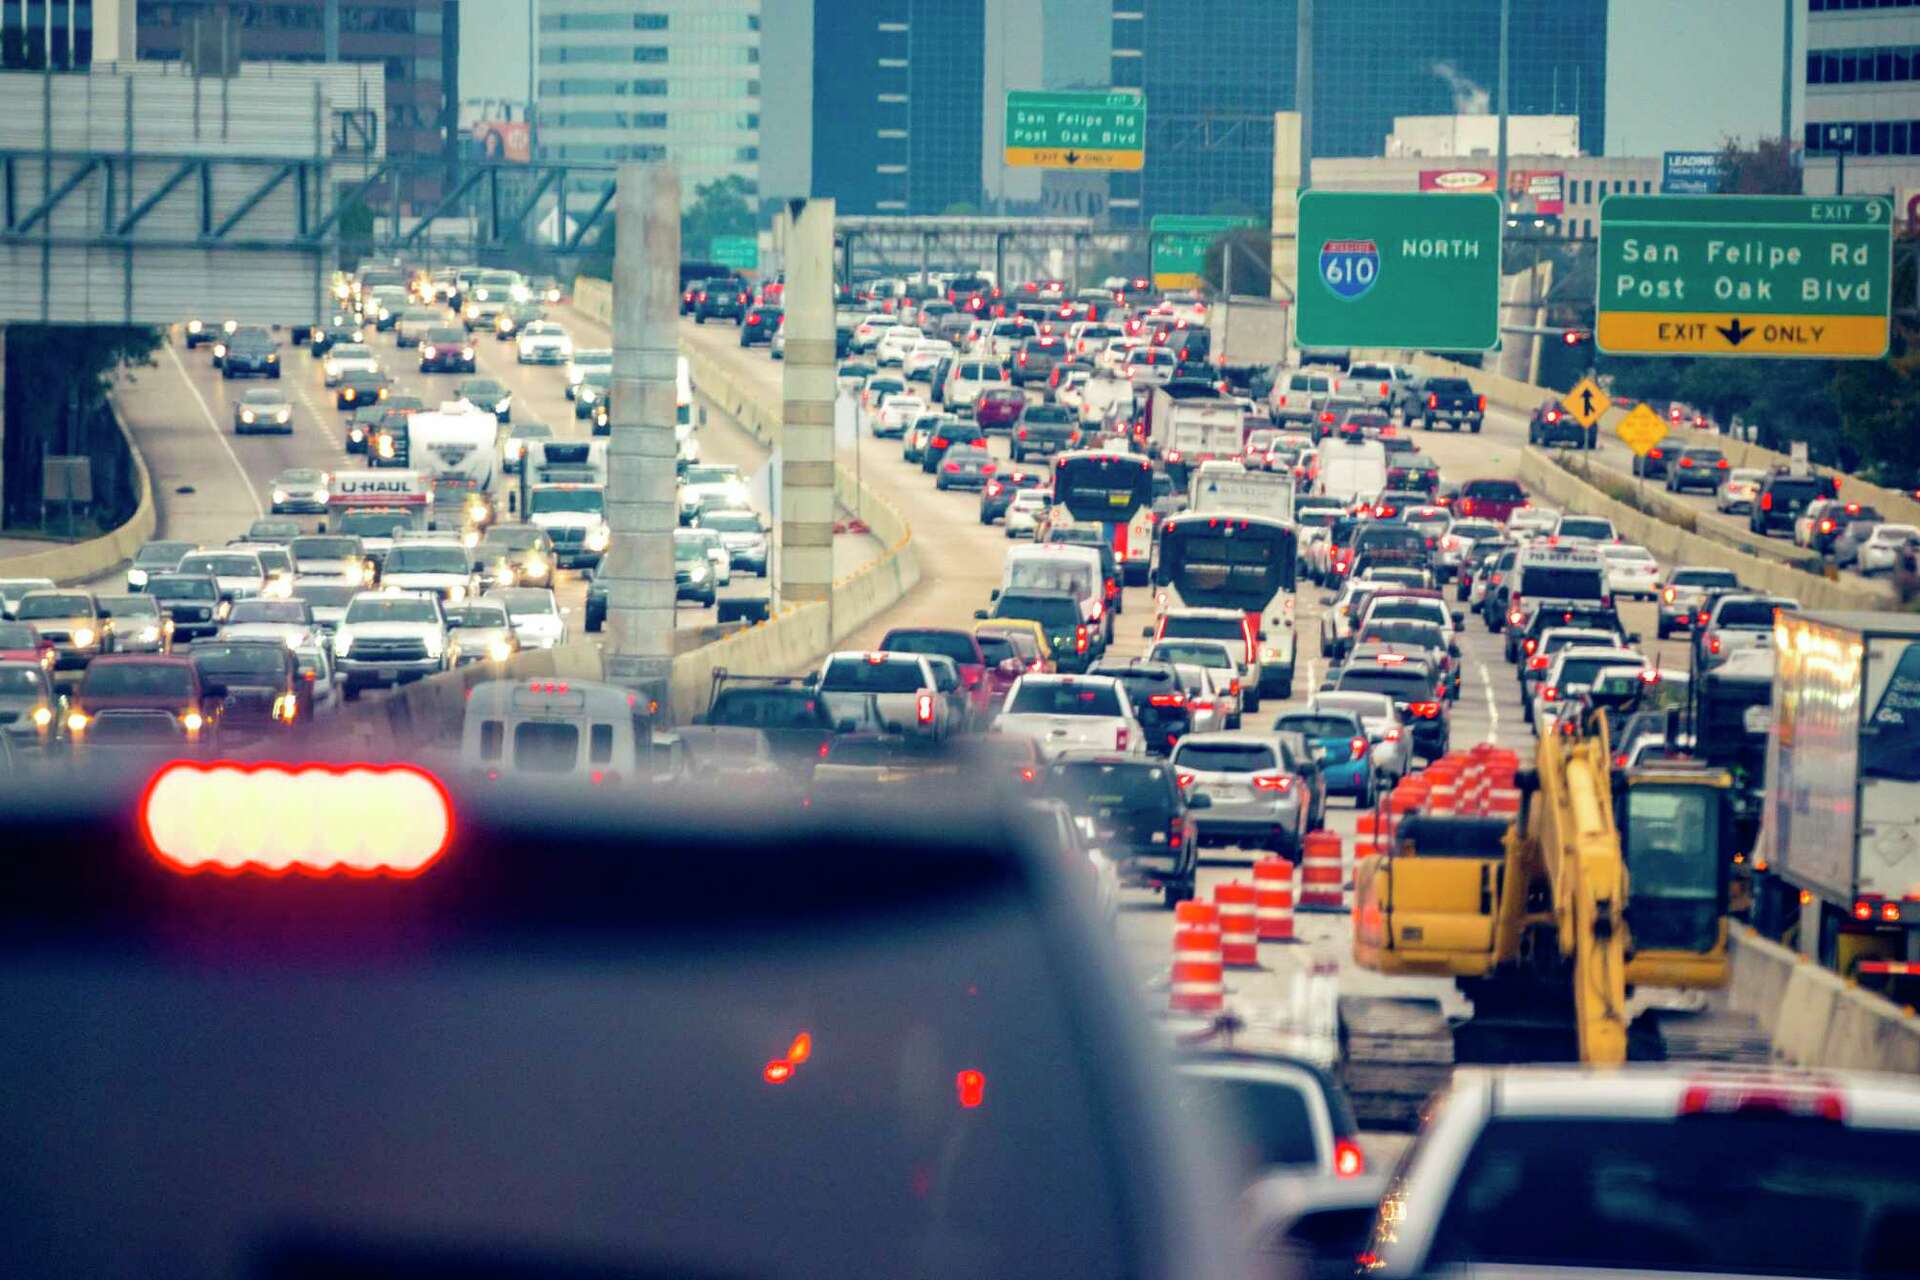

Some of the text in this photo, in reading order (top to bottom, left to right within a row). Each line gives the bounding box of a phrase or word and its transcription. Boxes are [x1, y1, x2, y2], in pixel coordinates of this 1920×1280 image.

[1016, 111, 1135, 128] San Felipe Rd
[1013, 129, 1137, 144] Post Oak Blvd
[1811, 200, 1882, 223] EXIT 9
[1402, 239, 1479, 259] NORTH
[1622, 238, 1869, 270] San Felipe Rd
[1326, 256, 1374, 285] 610
[1616, 274, 1871, 301] Post Oak Blvd
[1658, 322, 1825, 343] EXIT ONLY
[340, 480, 412, 493] U-HAUL
